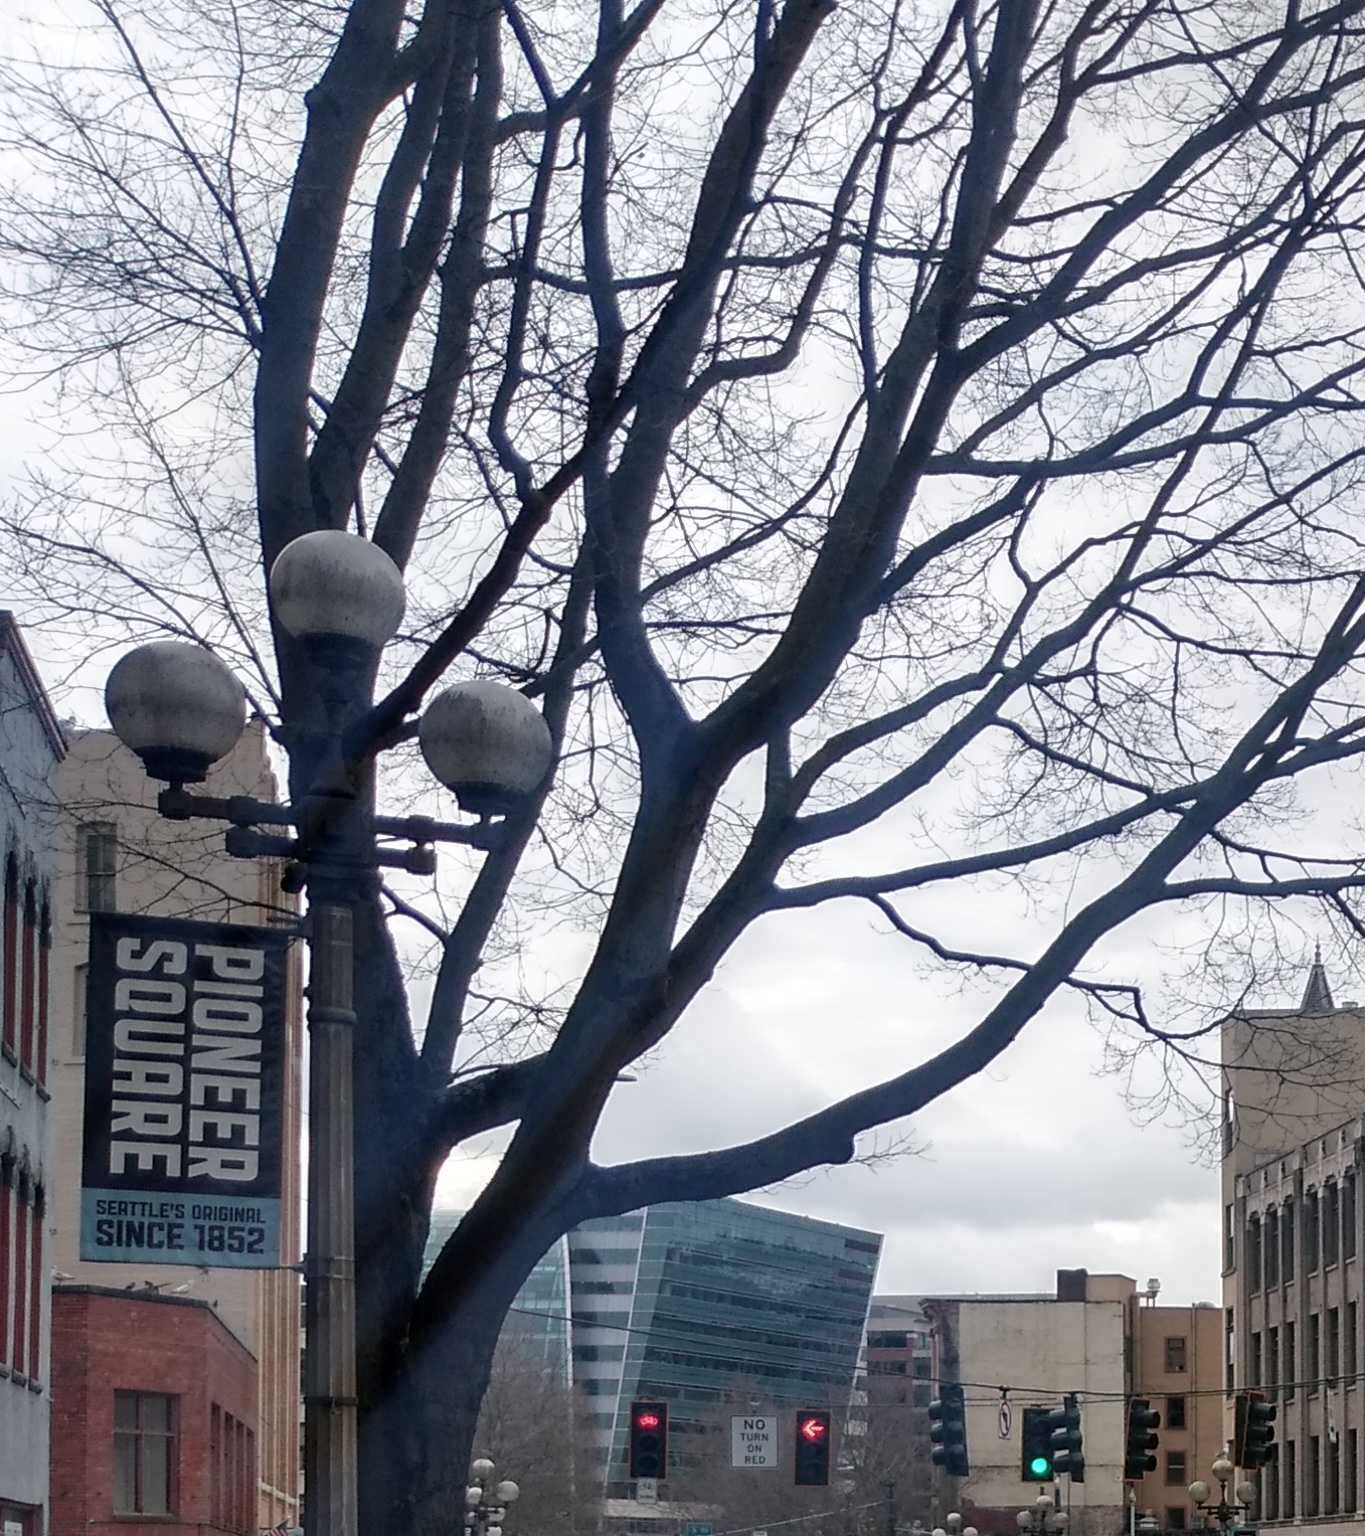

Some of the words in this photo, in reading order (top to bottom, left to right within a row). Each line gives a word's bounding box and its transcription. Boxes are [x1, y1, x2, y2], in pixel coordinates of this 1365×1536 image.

[109, 936, 188, 1179] SQUARE
[187, 943, 266, 1183] PIONEER
[95, 1199, 186, 1220] SEATTLE'S
[191, 1204, 267, 1225] ORIGINAL
[95, 1219, 185, 1251] SINCE
[193, 1223, 266, 1255] 1852
[743, 1419, 766, 1431] NO
[739, 1432, 769, 1442] TURN
[746, 1444, 762, 1454] ON
[744, 1455, 766, 1465] RED
